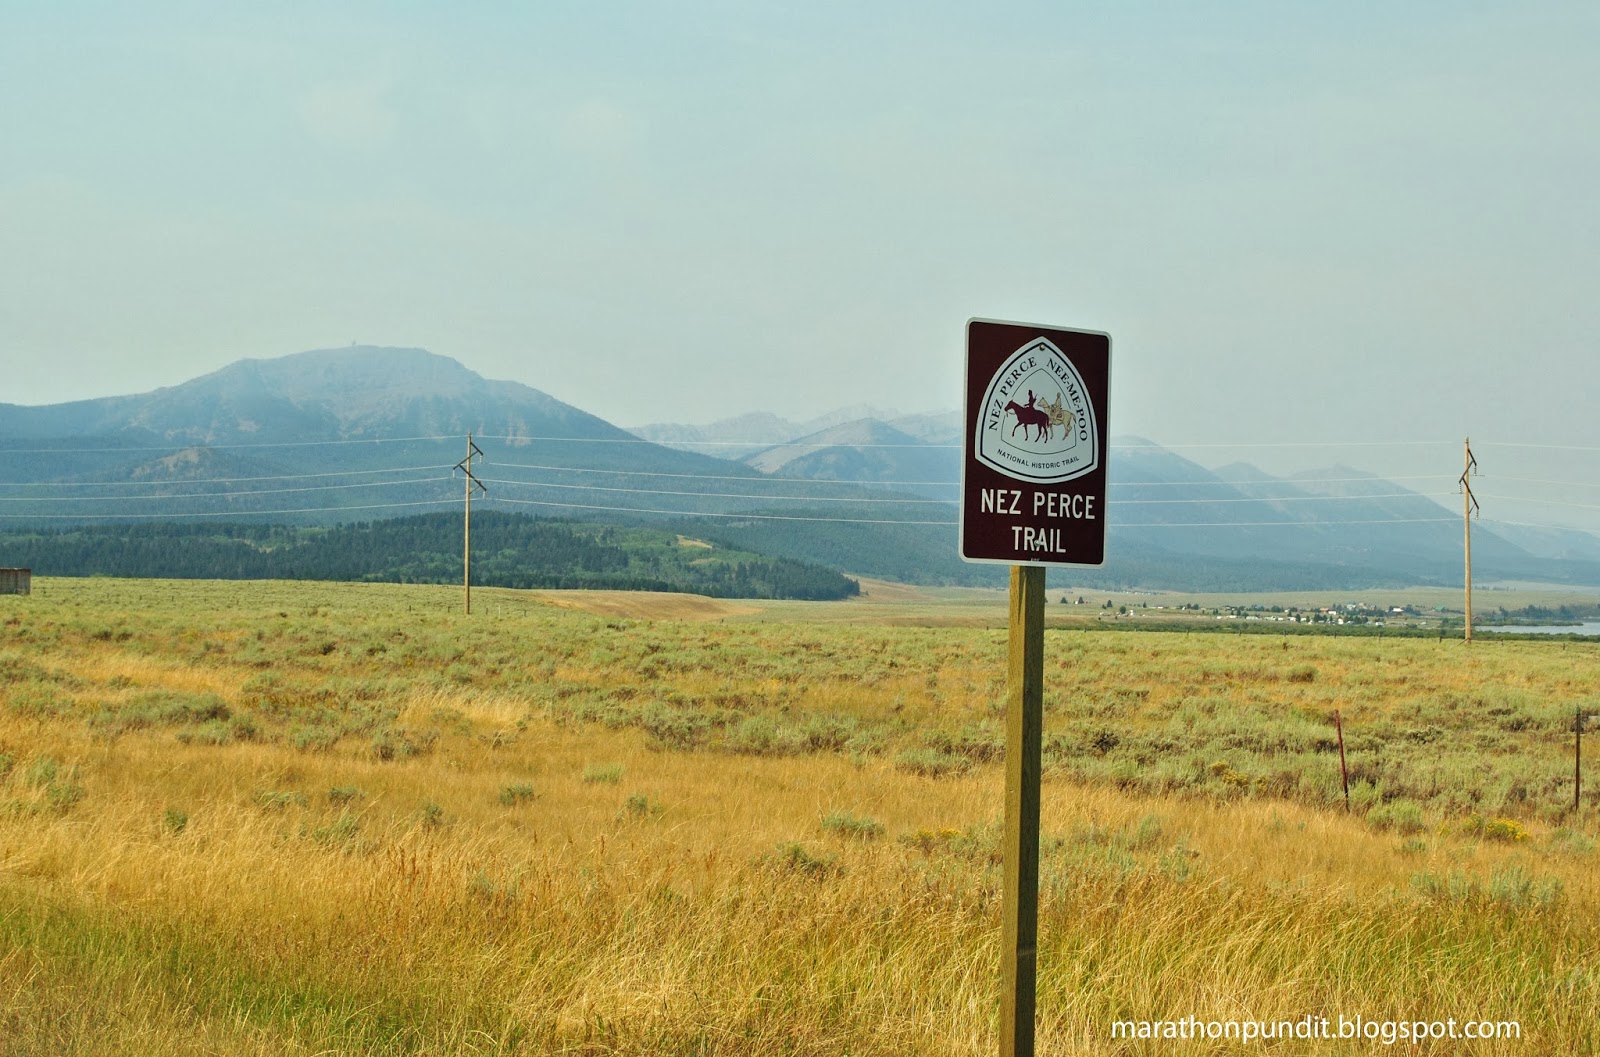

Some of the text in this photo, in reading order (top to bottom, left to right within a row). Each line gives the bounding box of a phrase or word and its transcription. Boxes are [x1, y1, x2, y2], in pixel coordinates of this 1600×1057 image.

[989, 357, 1037, 431] NEZ PERCE
[1046, 358, 1088, 442] NEE-ME-POO
[997, 449, 1080, 469] NATIONAL HISTORIC TRAIL
[981, 488, 1096, 520] NEZ PERCE
[1011, 525, 1067, 553] TRAIL
